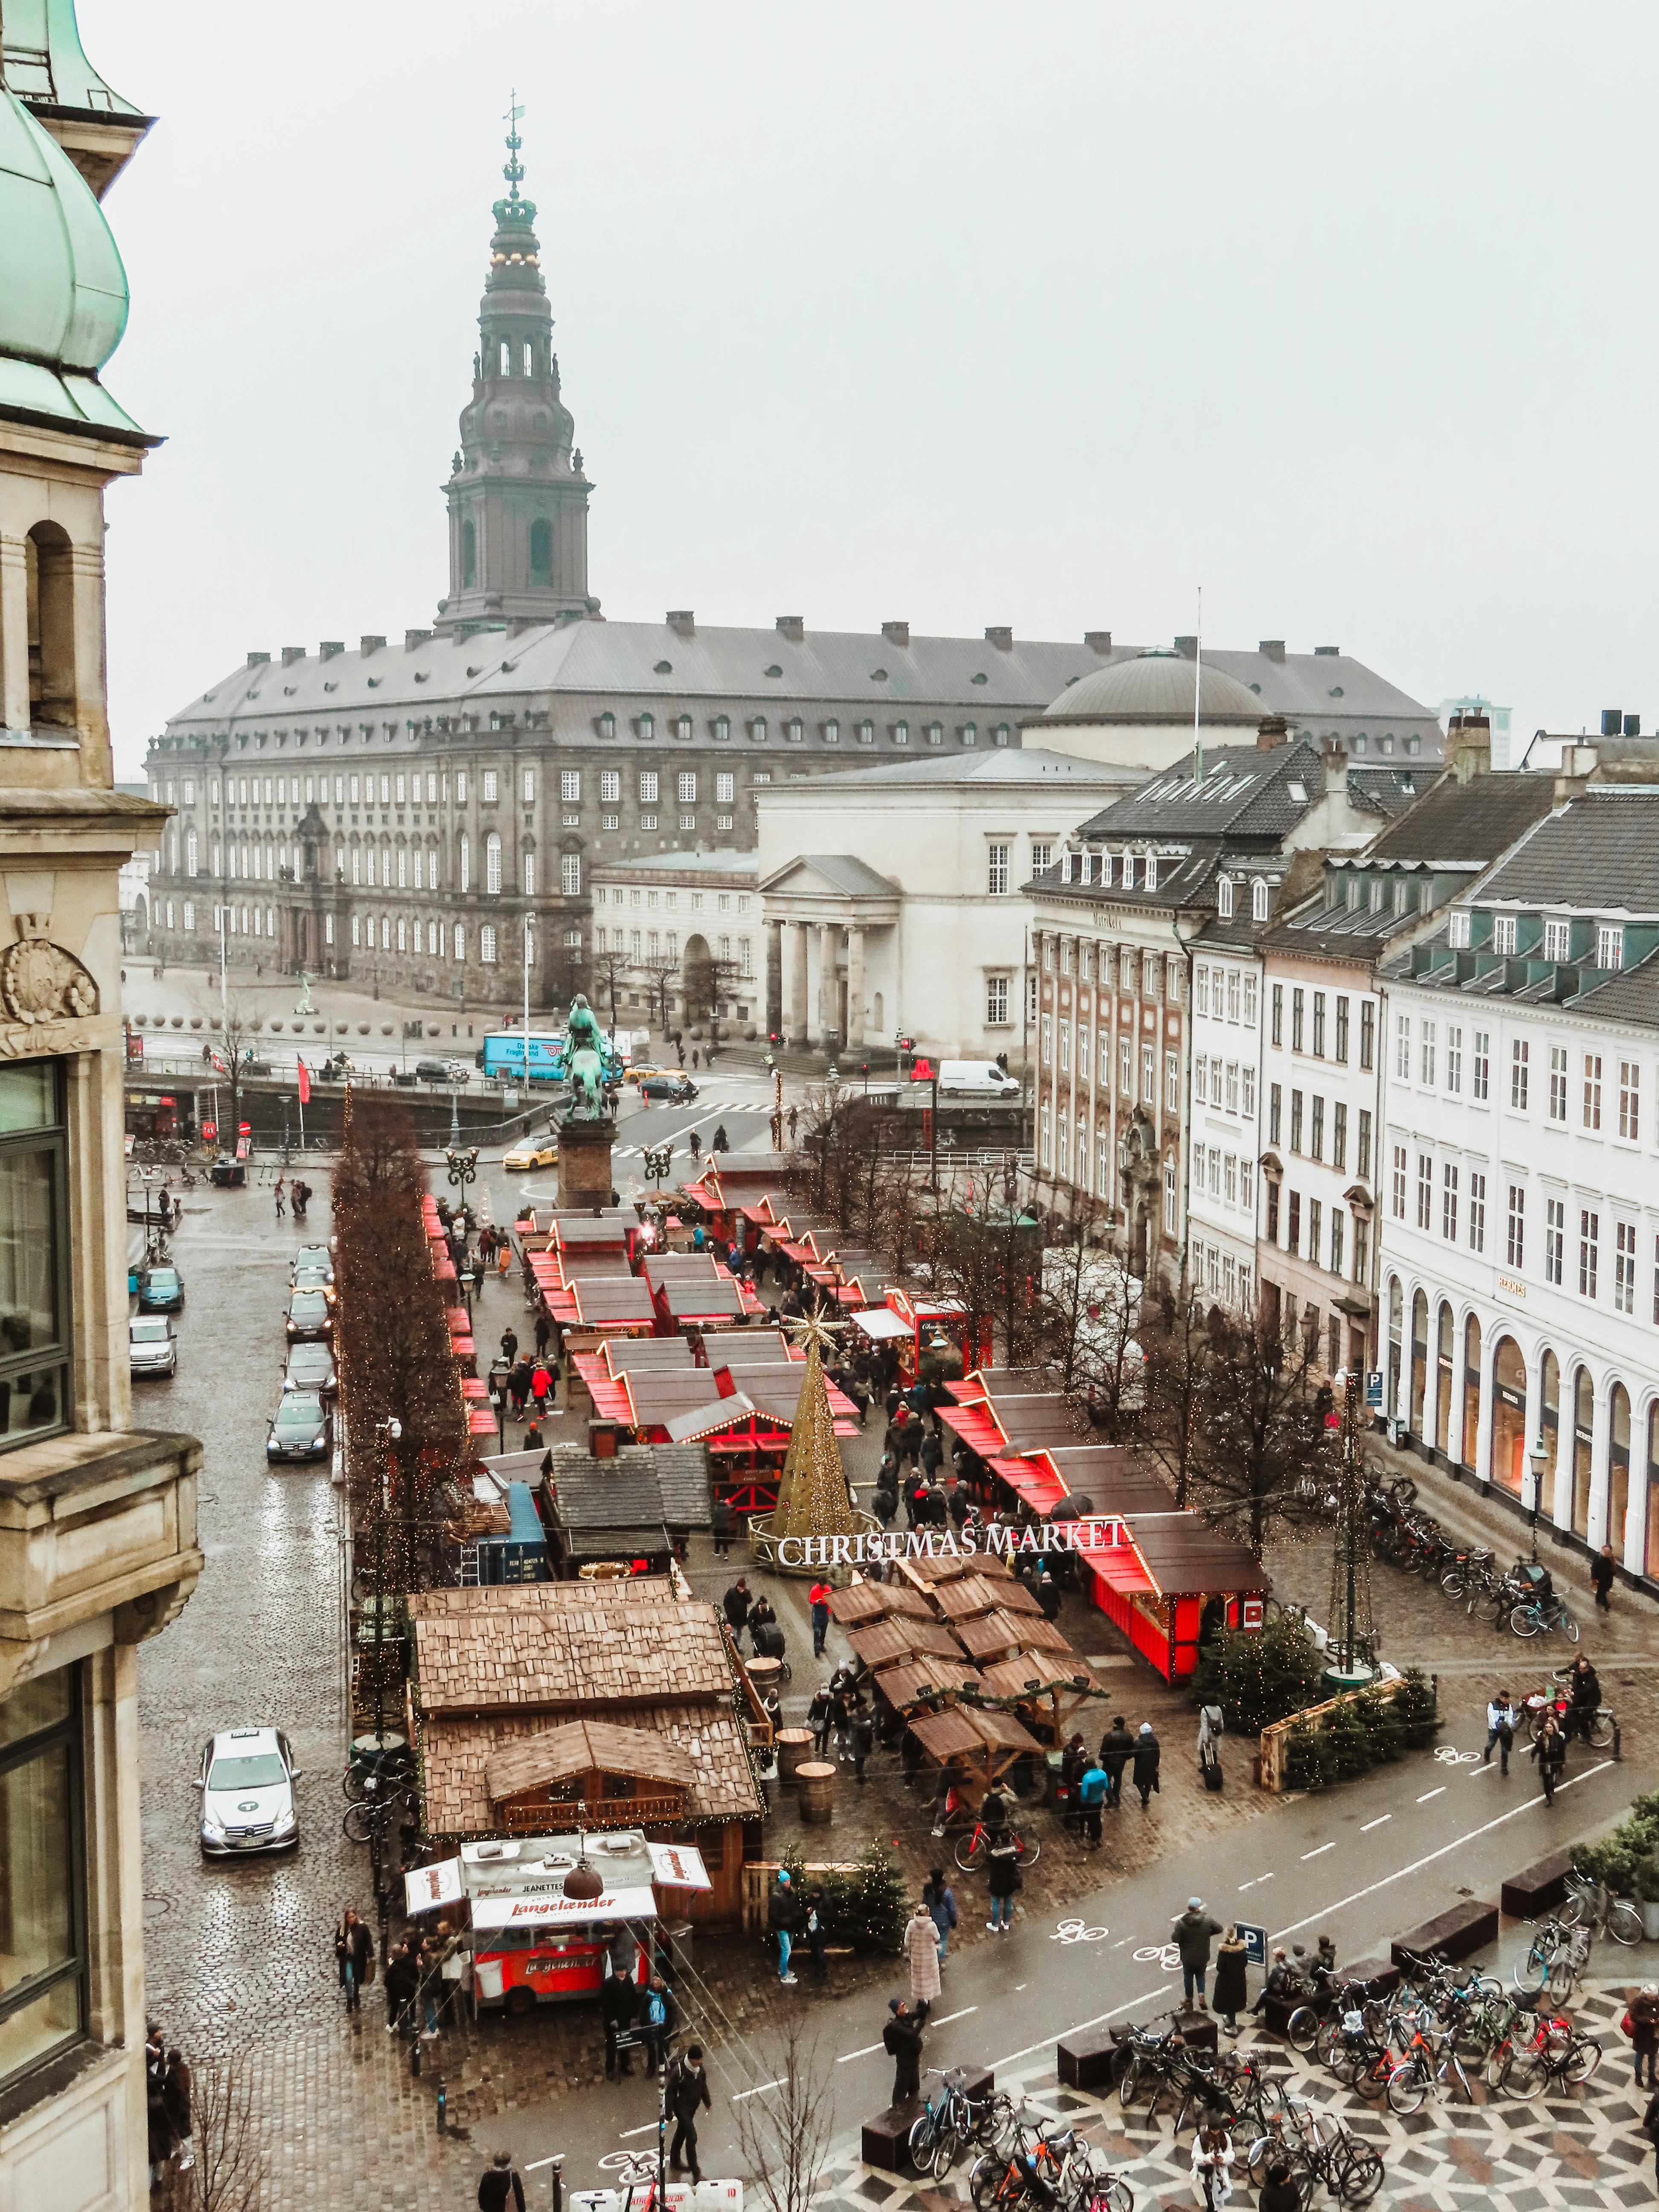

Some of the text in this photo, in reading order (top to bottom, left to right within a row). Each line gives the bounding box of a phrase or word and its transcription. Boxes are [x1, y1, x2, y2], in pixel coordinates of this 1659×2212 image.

[1370, 1374, 1380, 1387] P
[778, 1520, 1125, 1566] CHRISTMAS MARKET
[523, 1883, 564, 1893] JEANETTES
[512, 1895, 616, 1917] Langelænder
[1244, 1930, 1257, 1949] P
